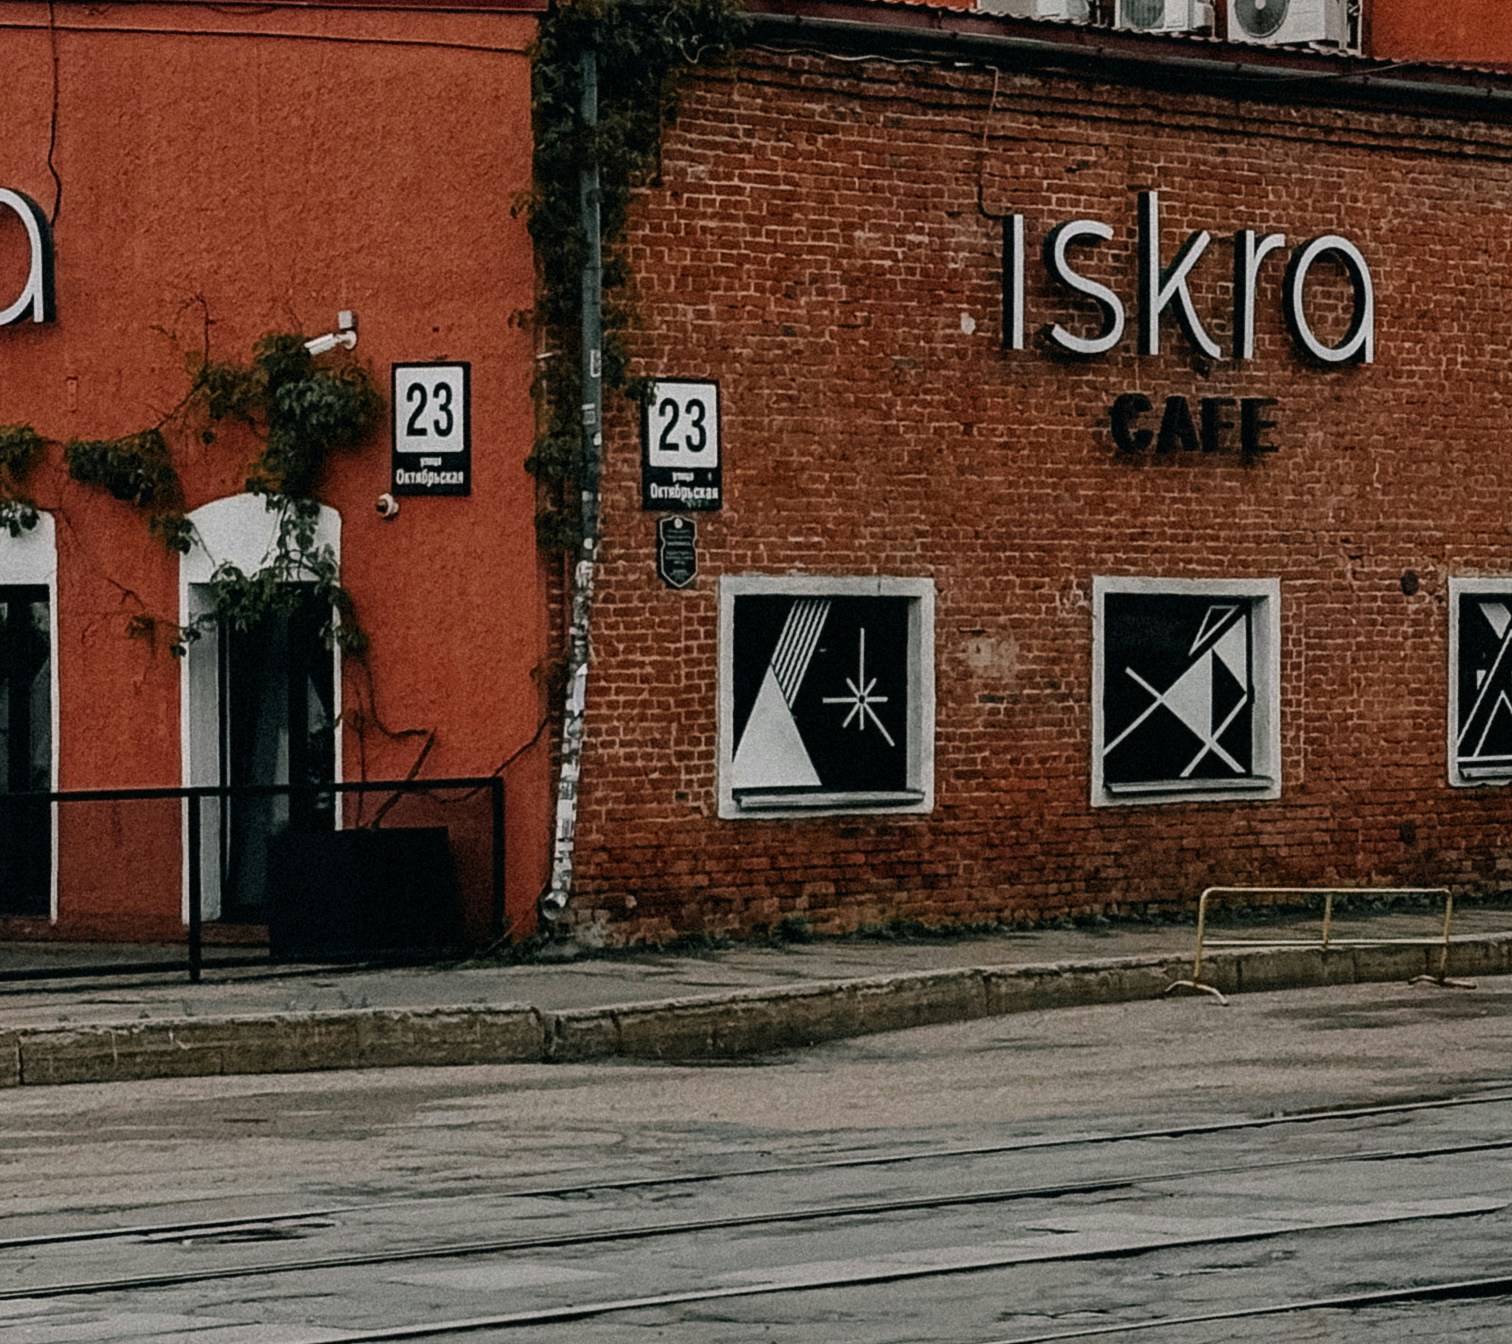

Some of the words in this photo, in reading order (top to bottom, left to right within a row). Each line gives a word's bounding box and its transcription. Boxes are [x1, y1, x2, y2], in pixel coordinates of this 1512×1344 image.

[405, 381, 454, 438] 23
[658, 397, 707, 453] 23
[1110, 392, 1281, 454] CAFE
[396, 468, 464, 487] Октябрьская
[650, 482, 719, 502] Октябрьская
